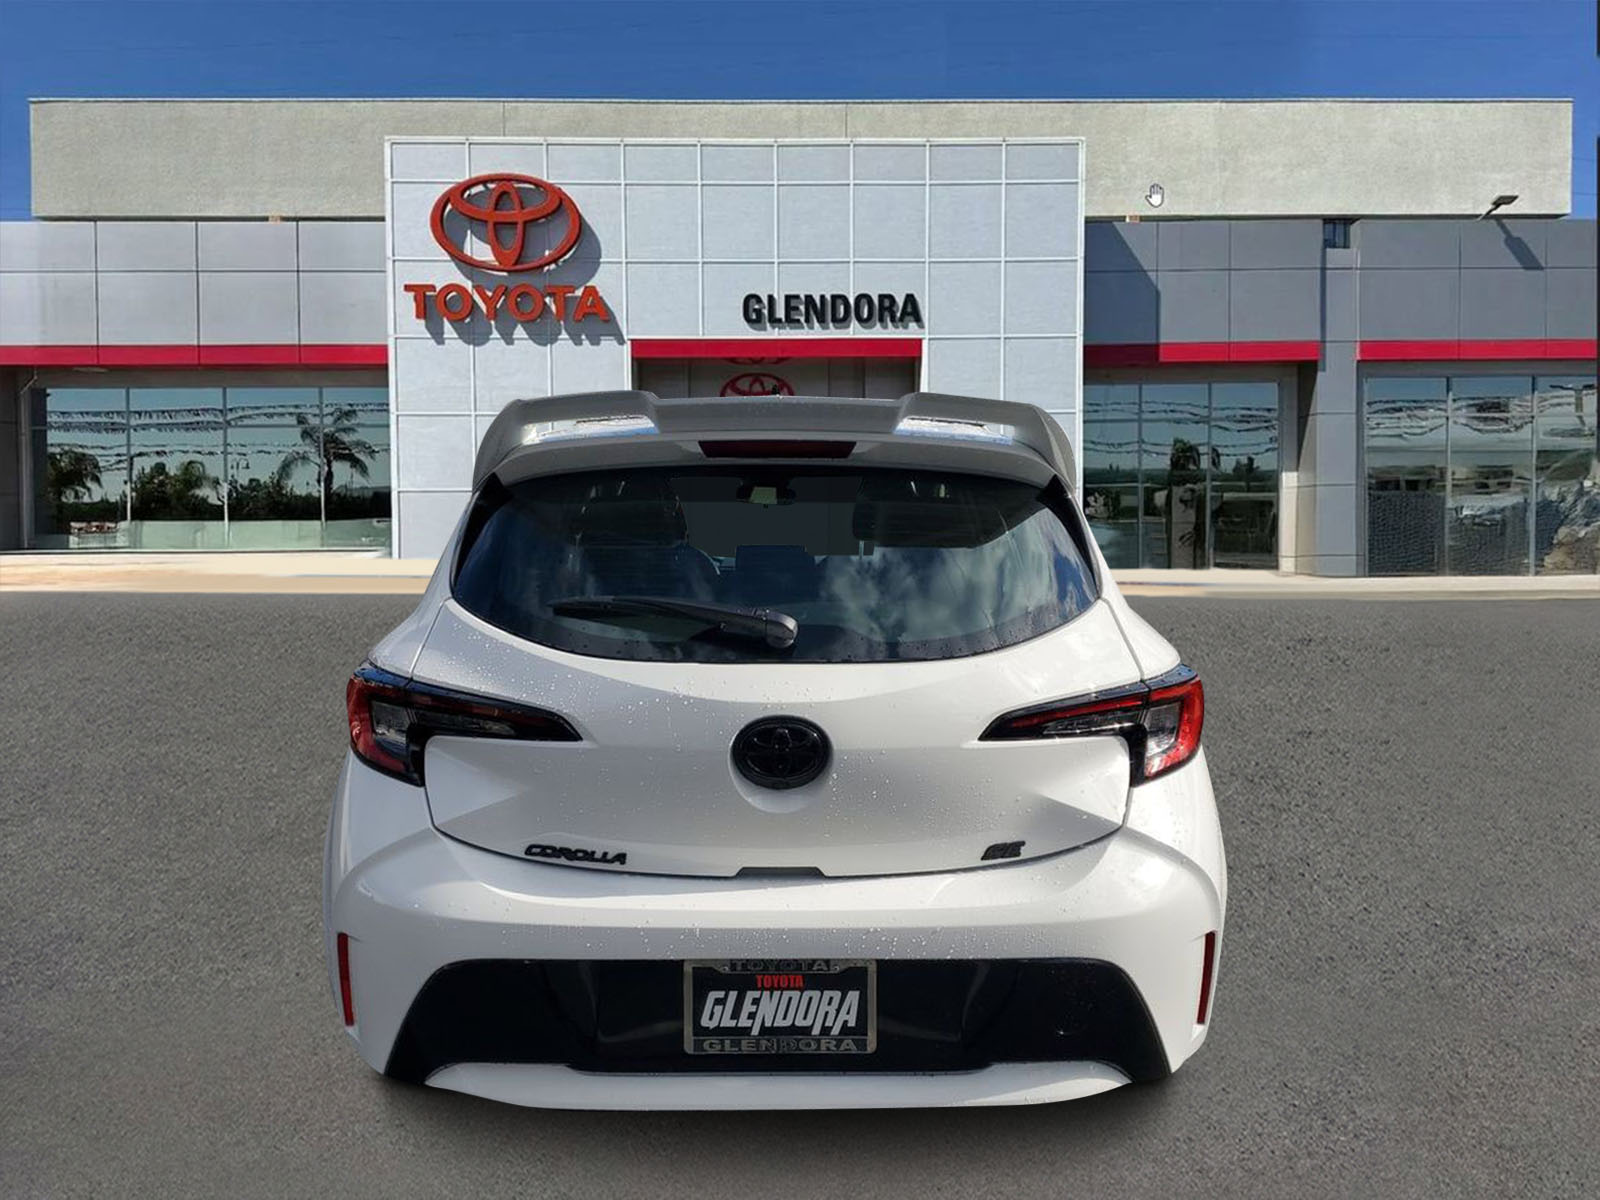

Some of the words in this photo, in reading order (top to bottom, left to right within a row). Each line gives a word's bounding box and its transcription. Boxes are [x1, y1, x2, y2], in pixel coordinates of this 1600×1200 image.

[404, 284, 610, 322] TOYOTA
[743, 292, 923, 326] GLENDORA
[525, 844, 627, 865] COROLLA
[731, 959, 829, 971] TOYOTA
[755, 975, 804, 987] TOYOTA
[700, 990, 860, 1036] GLENDORA
[702, 1039, 858, 1051] GLENDORA
